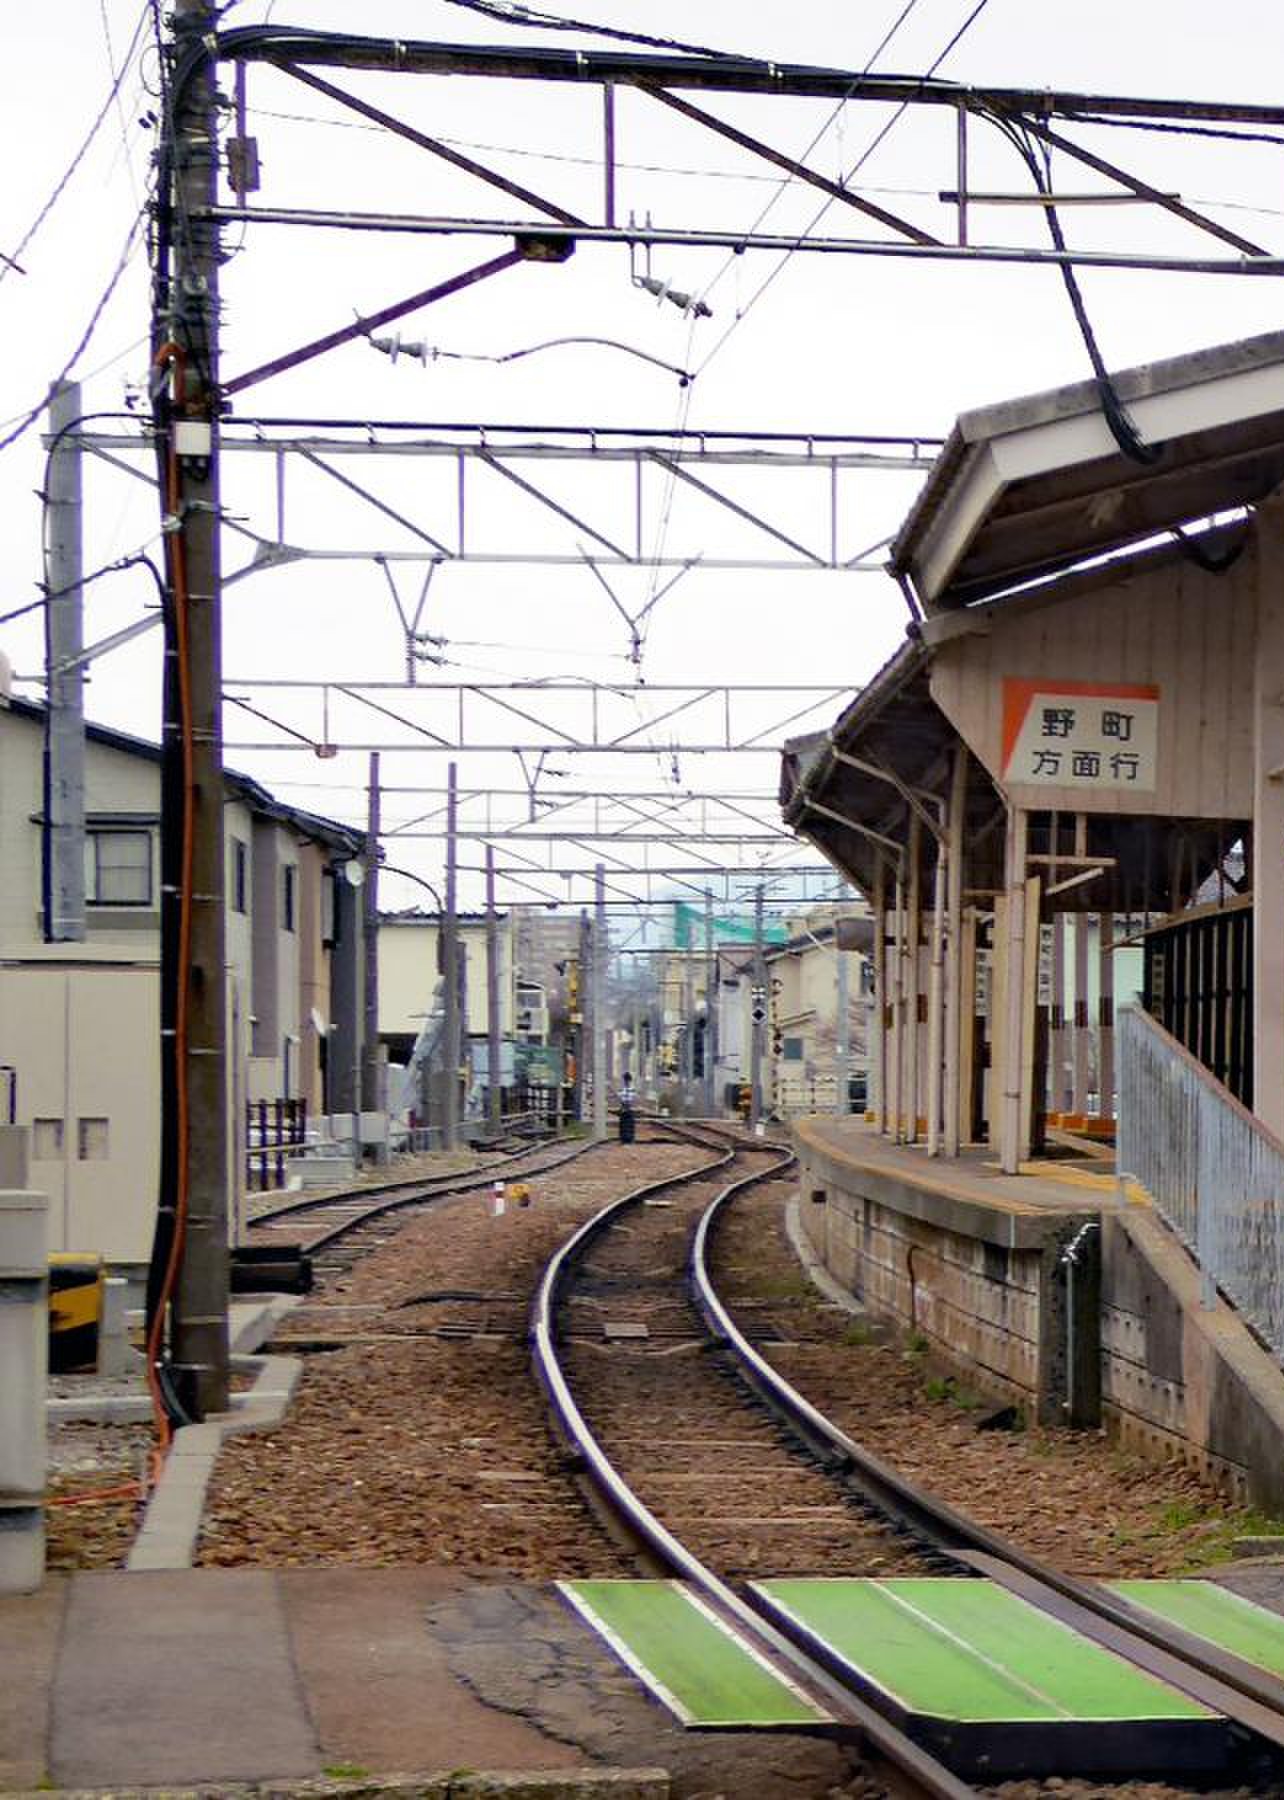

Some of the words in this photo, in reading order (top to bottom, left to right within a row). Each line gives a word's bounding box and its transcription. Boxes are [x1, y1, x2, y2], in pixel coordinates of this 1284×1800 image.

[1041, 708, 1135, 741] 野町
[1031, 749, 1139, 780] 方面行
